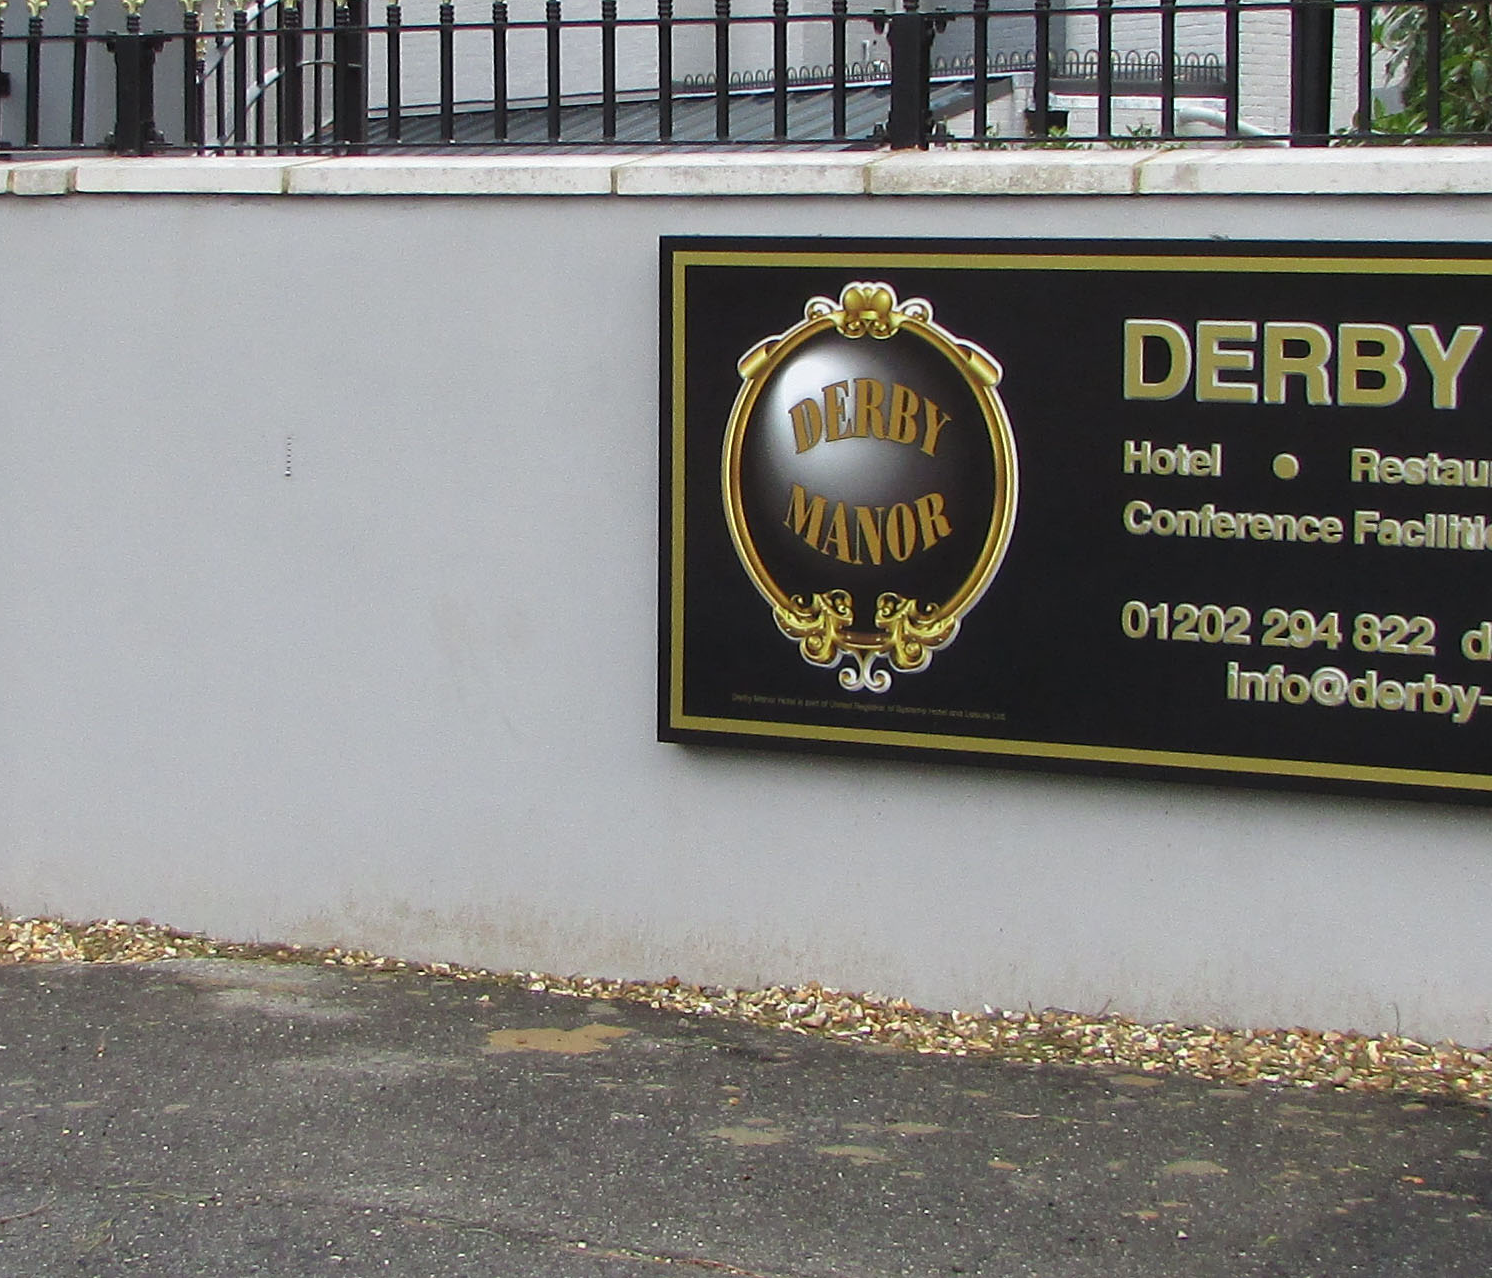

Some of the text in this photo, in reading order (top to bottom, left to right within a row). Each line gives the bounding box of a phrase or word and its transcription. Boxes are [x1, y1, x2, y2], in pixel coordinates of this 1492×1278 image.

[1124, 319, 1483, 409] DERBY
[787, 377, 951, 456] DERBY
[1124, 440, 1221, 476] Hotel
[783, 483, 952, 565] MANOR
[1124, 501, 1343, 543] Conference
[1122, 601, 1251, 645] 01202
[1262, 608, 1343, 649] 294
[1353, 613, 1436, 656] 822
